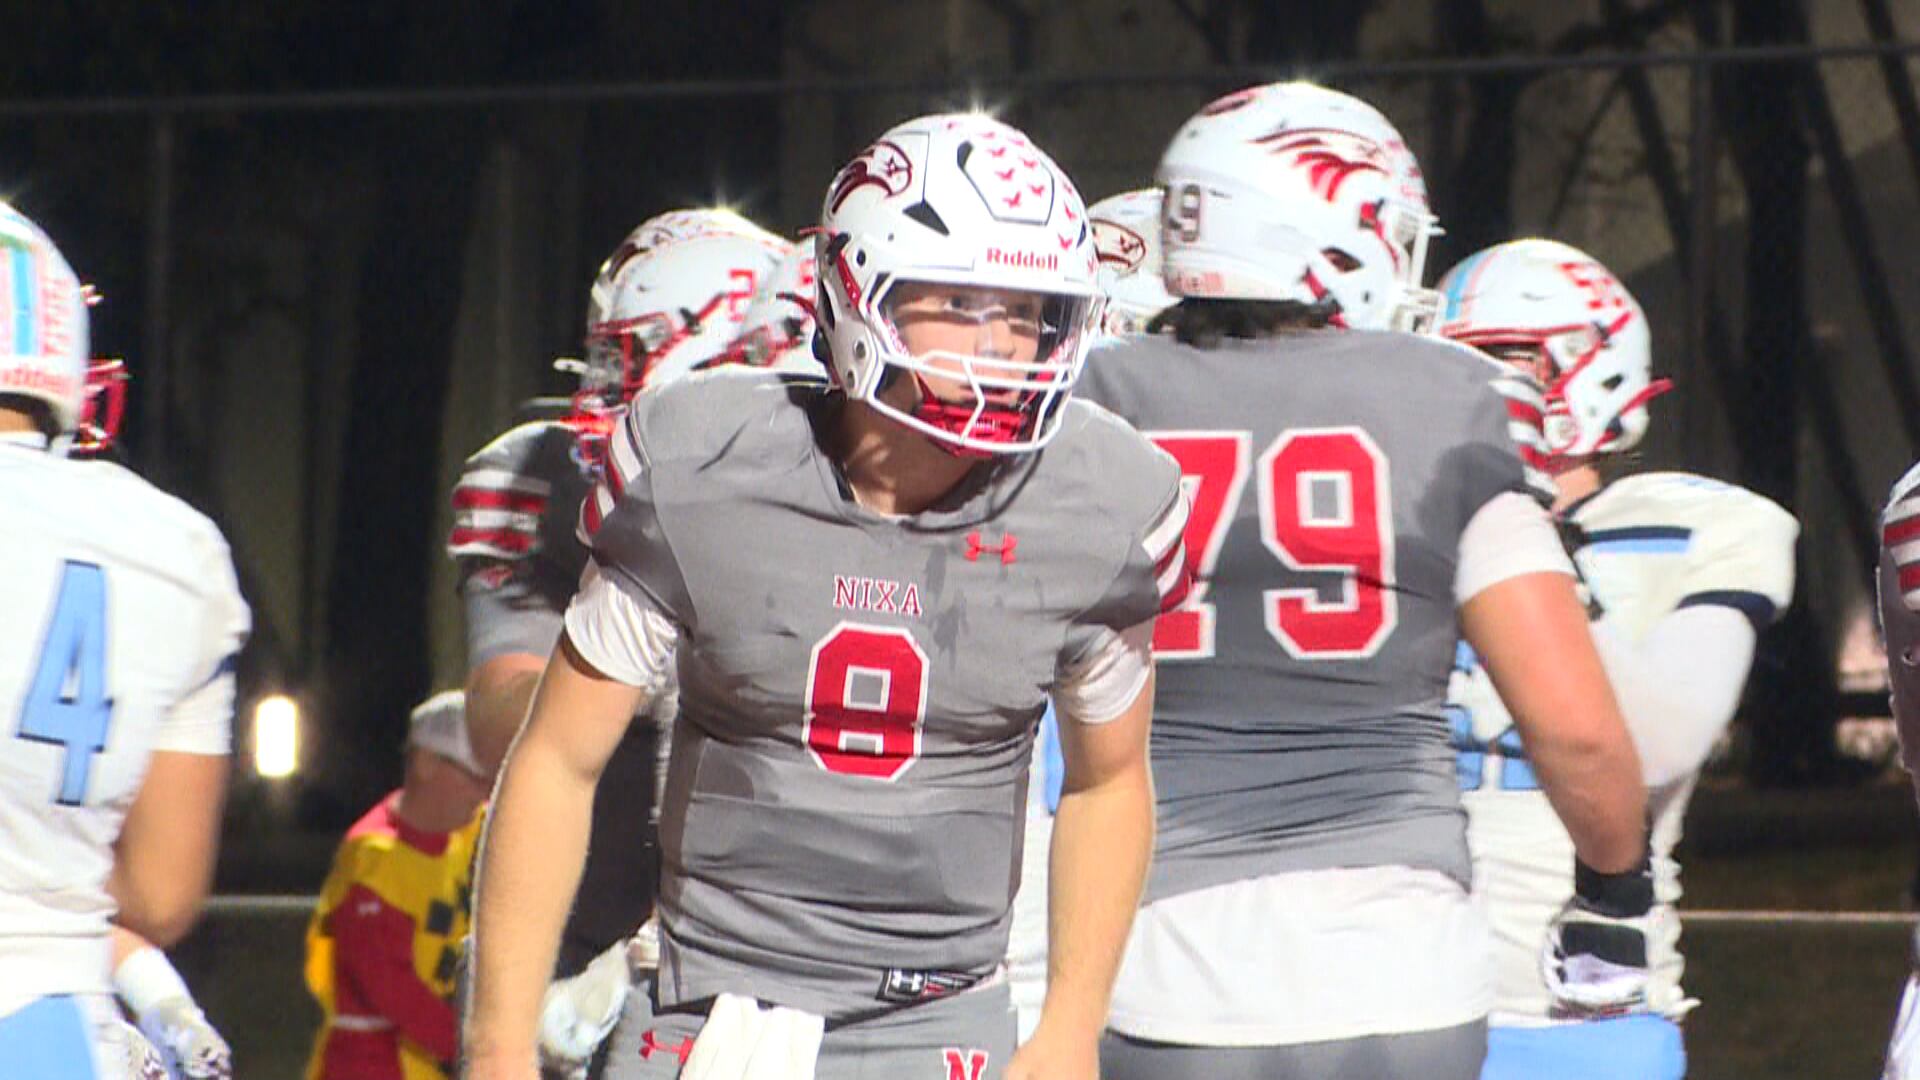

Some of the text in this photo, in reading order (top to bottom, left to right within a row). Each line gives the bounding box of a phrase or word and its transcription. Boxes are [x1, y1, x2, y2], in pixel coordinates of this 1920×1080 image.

[986, 247, 1059, 272] Riddell
[1137, 426, 1399, 661] 79
[832, 574, 923, 618] NIXA
[15, 557, 115, 807] 4
[801, 620, 930, 783] 8
[942, 1047, 989, 1080] N
